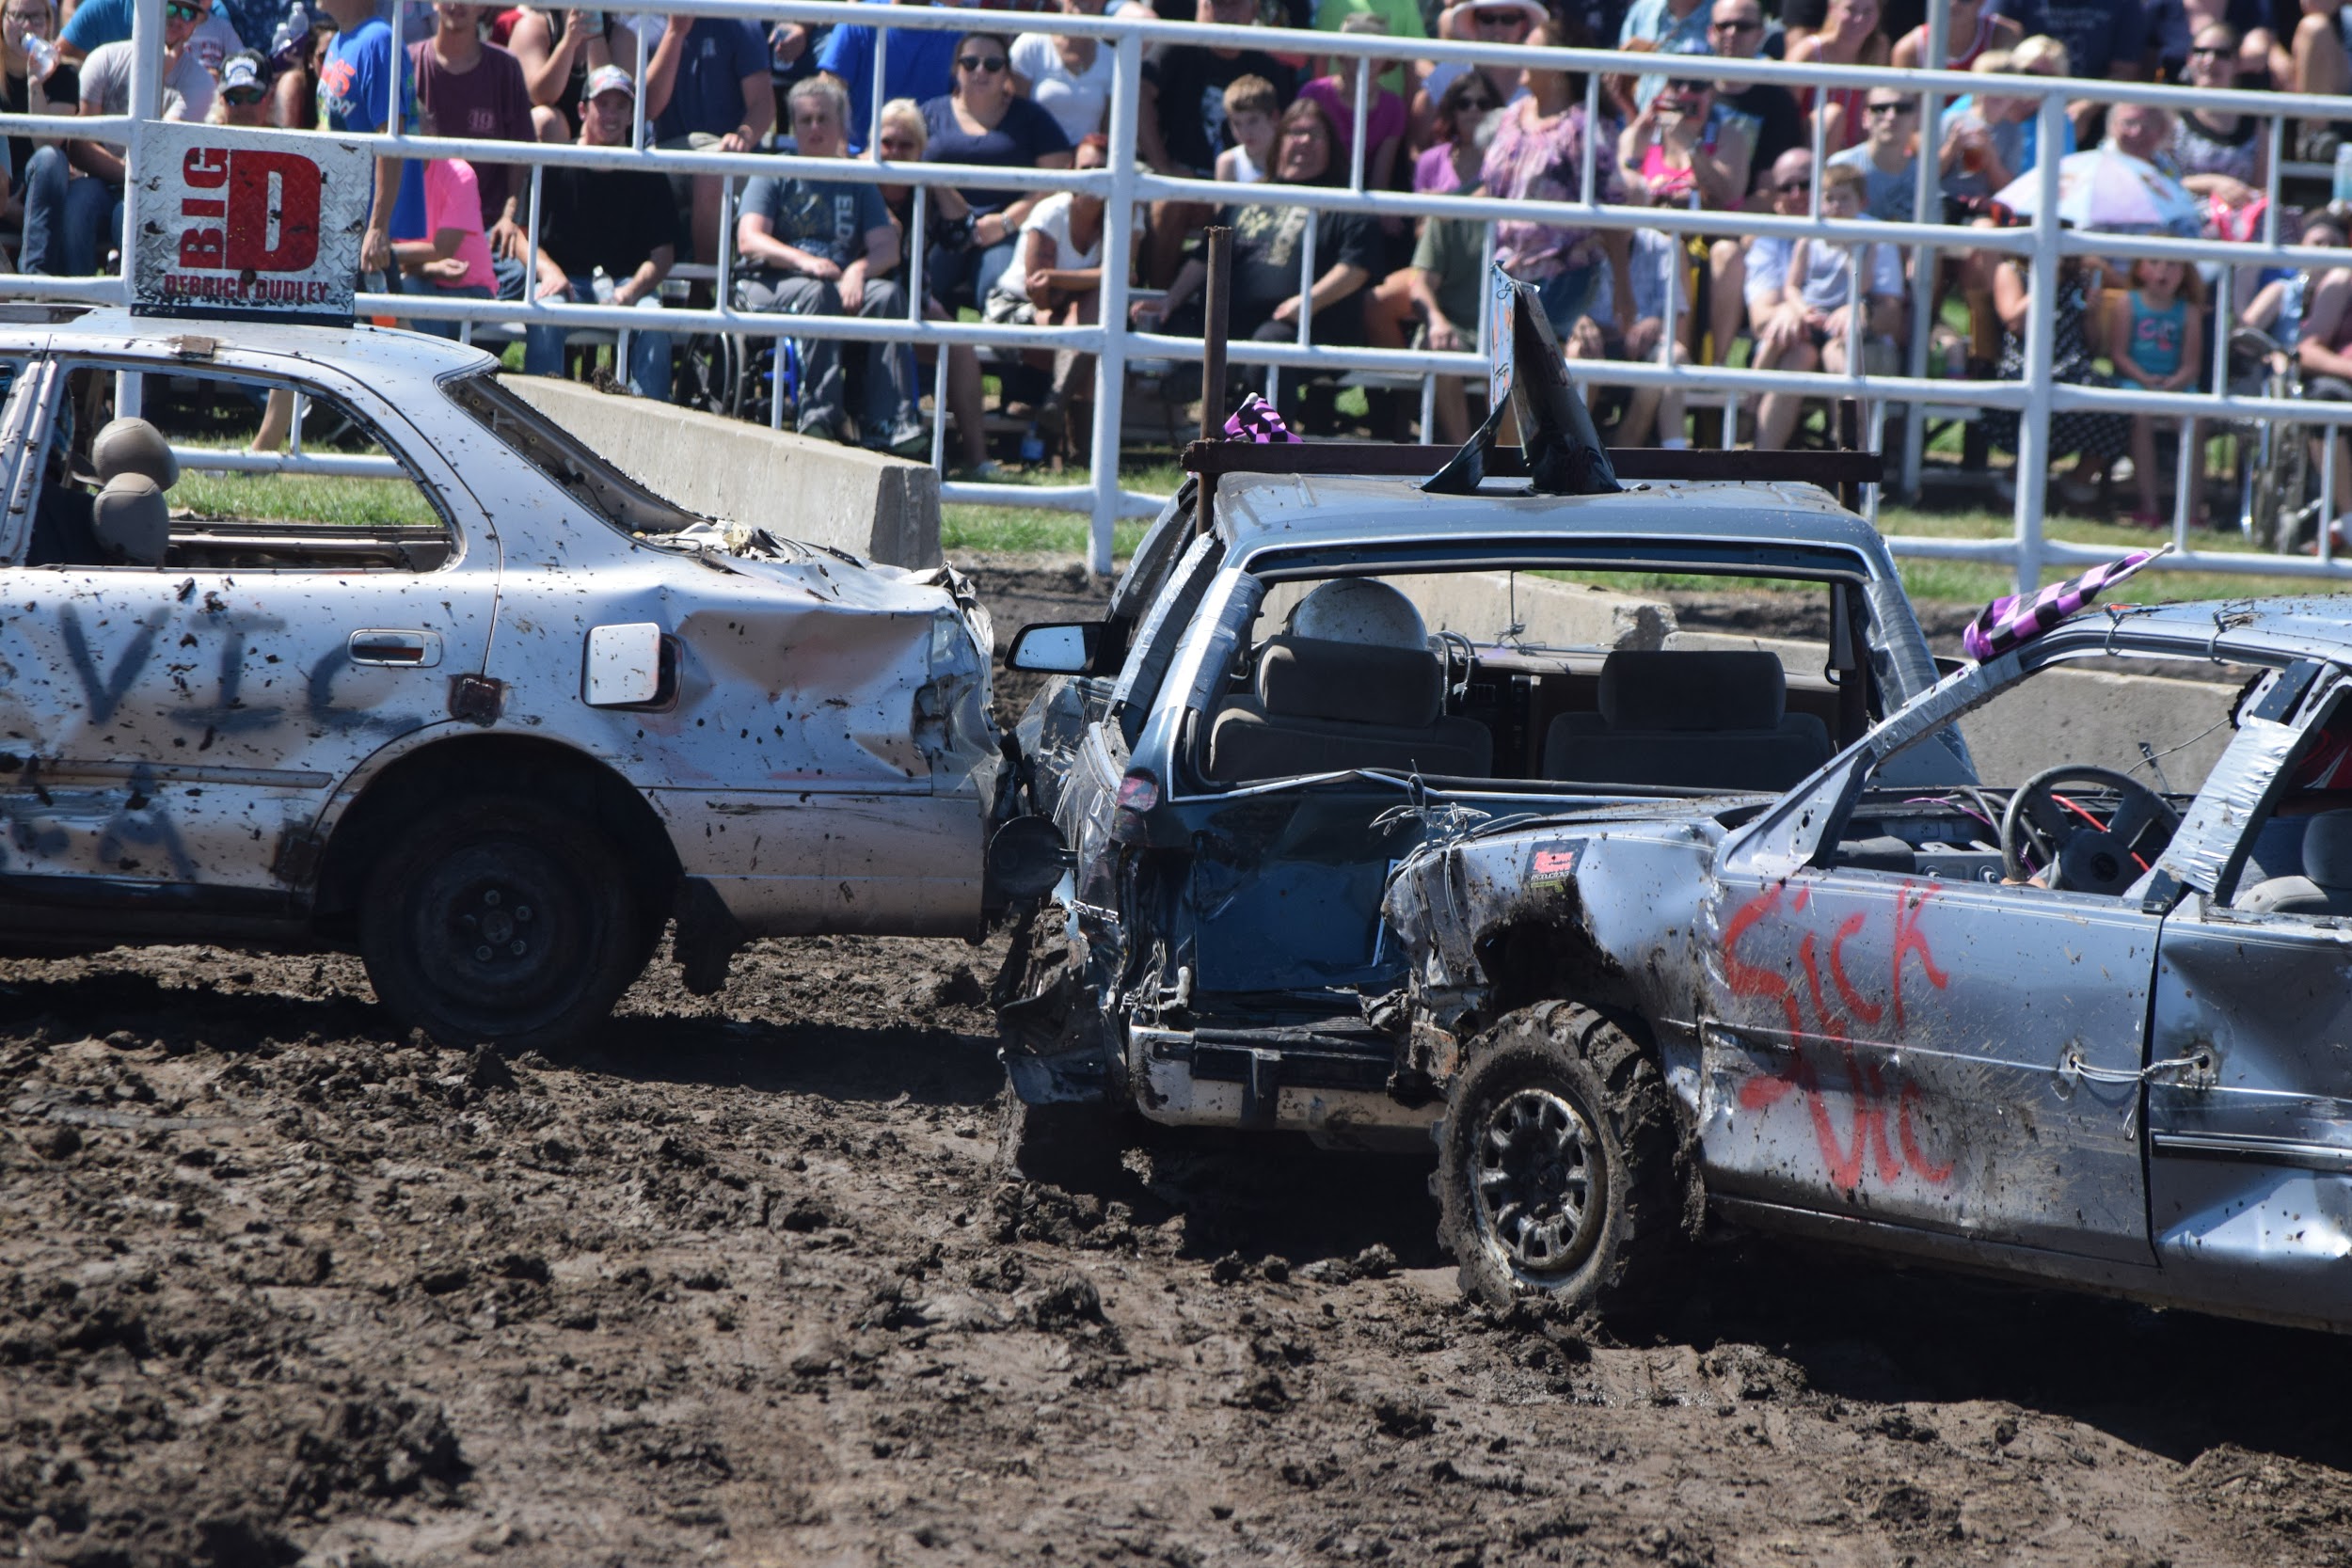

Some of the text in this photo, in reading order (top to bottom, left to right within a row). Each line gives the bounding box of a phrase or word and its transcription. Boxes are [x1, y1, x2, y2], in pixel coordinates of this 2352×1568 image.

[179, 147, 322, 272] BIG D
[255, 278, 329, 303] DUDLEY
[58, 602, 423, 734] VIC
